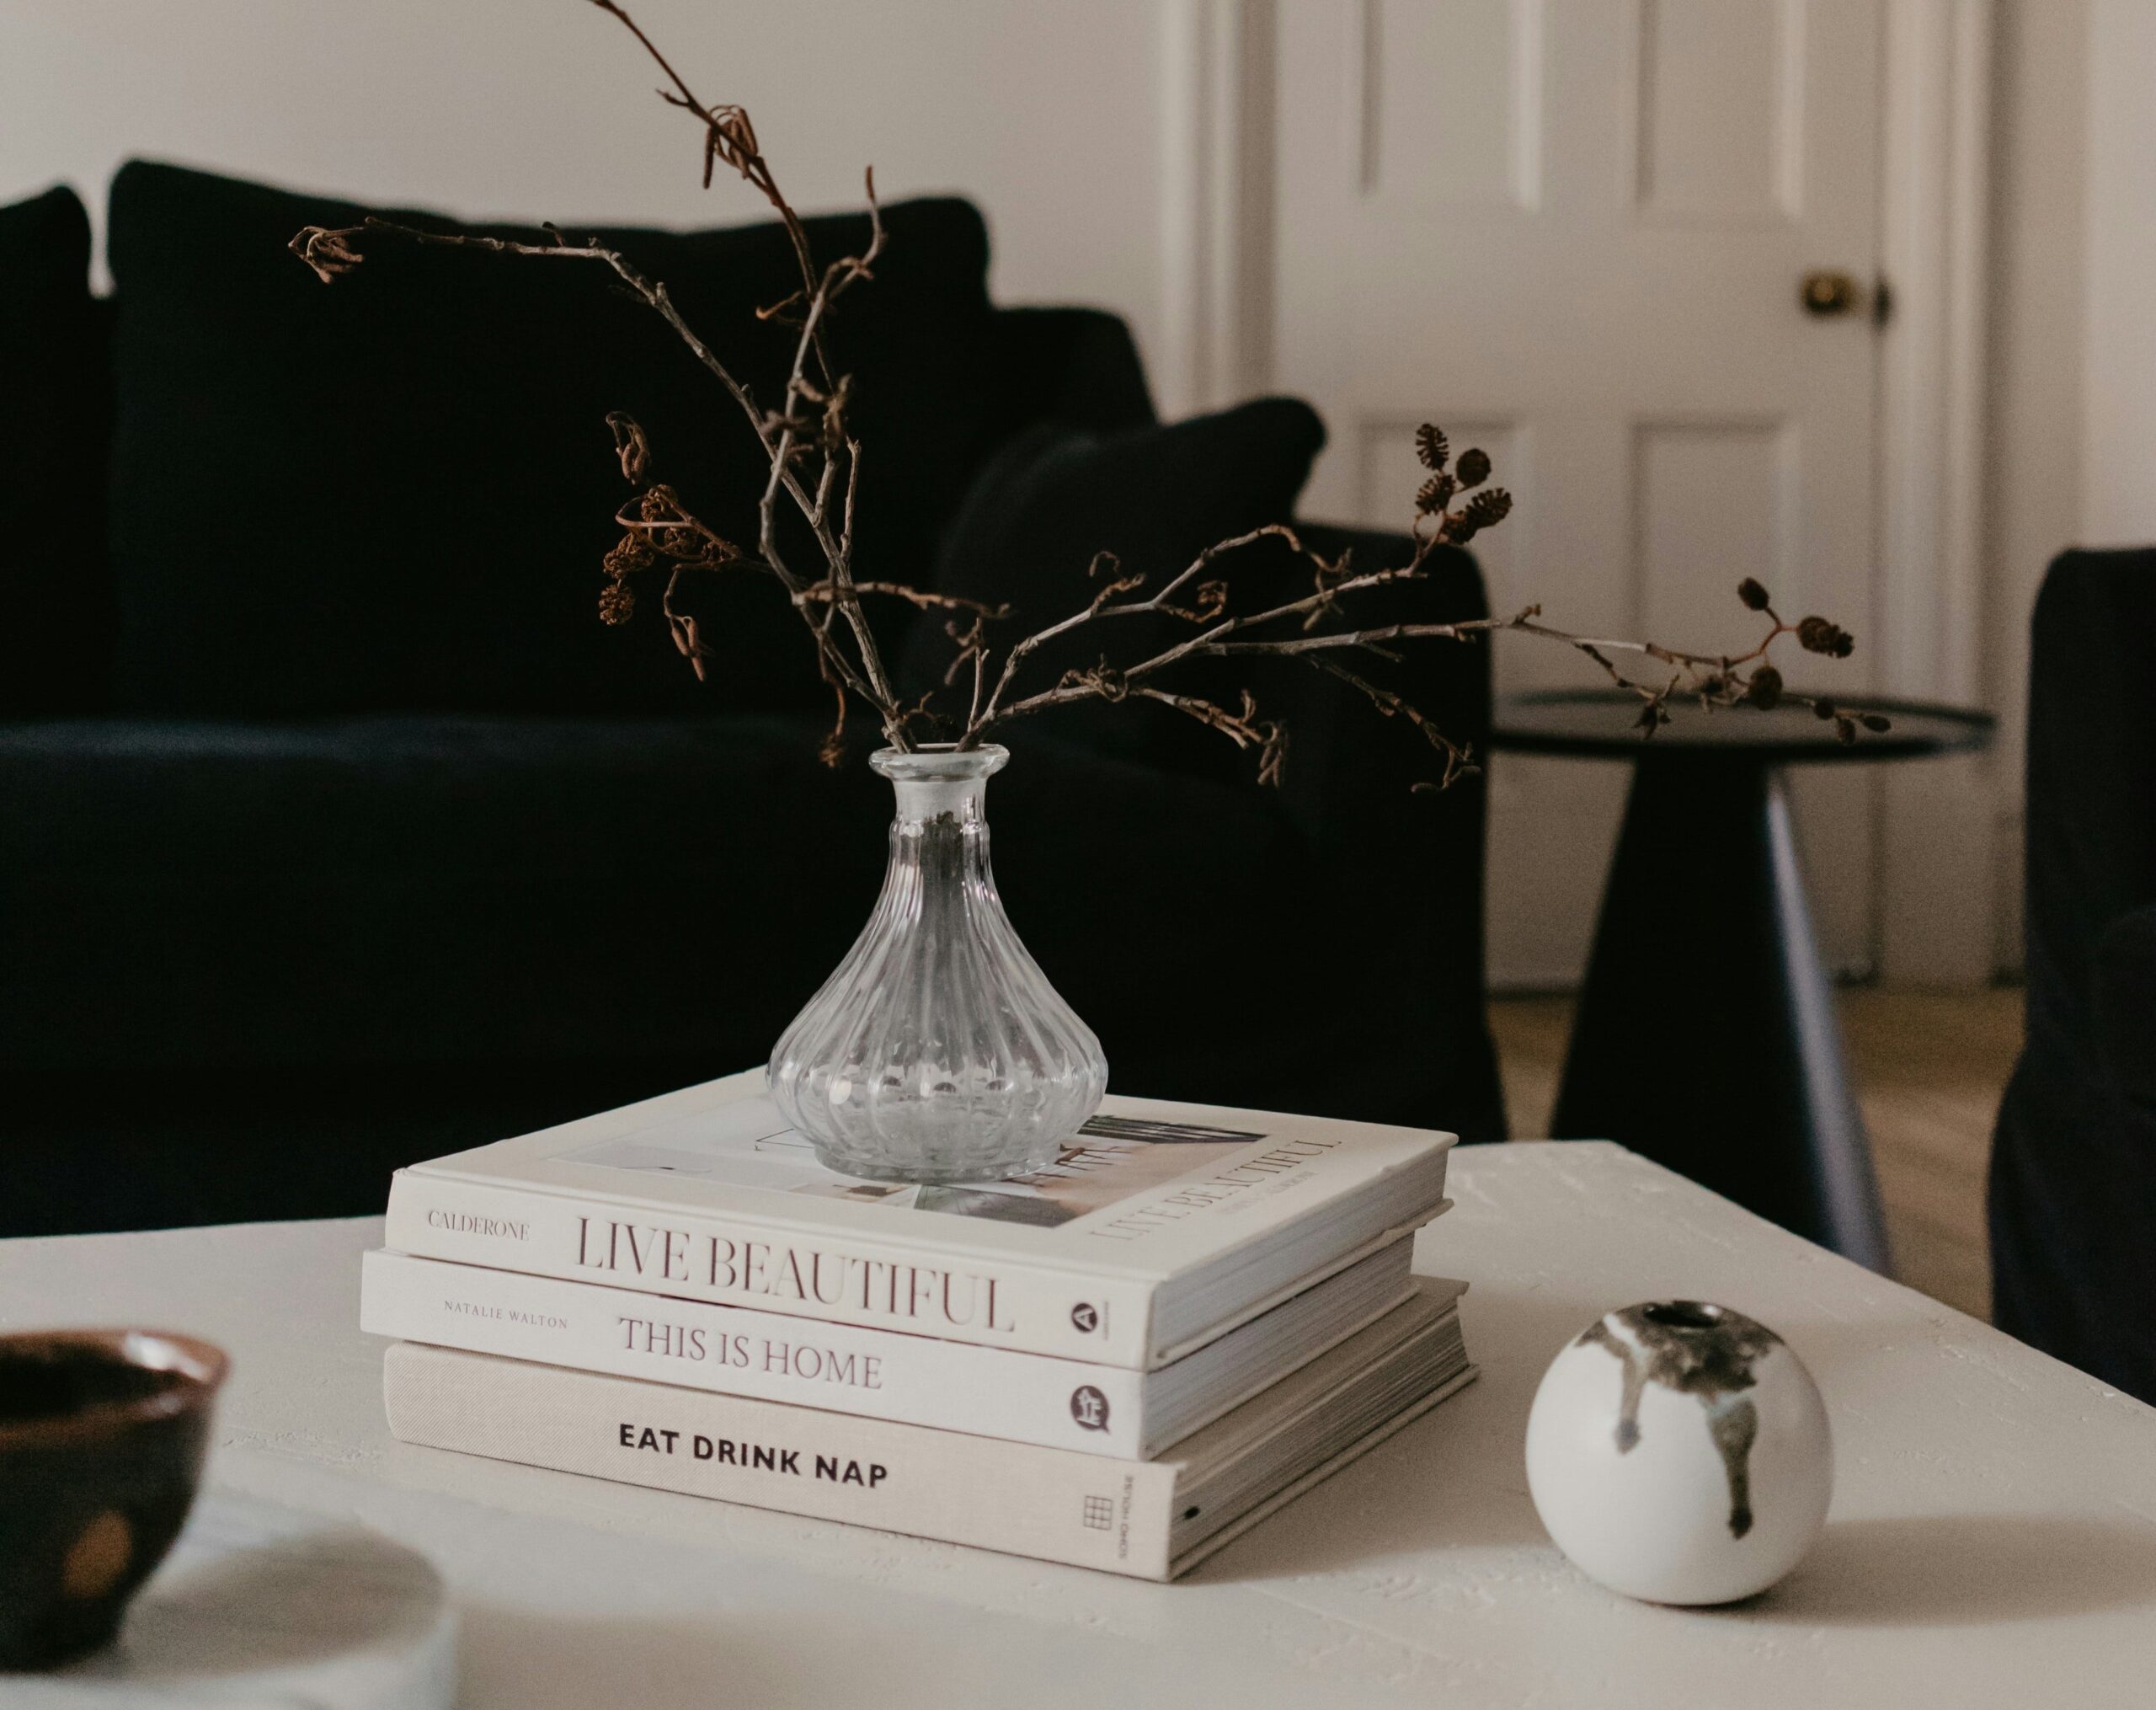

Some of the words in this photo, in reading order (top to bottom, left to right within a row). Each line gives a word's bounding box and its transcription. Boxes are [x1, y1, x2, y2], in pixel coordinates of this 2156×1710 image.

[1090, 1206, 1191, 1240] LIVE
[1164, 1140, 1342, 1208] BEAUTIFUL
[428, 1210, 531, 1242] CALDERONE
[576, 1216, 691, 1281] LIVE
[707, 1236, 1015, 1333] BEAUTIFUL
[444, 1300, 503, 1320] NATALIE
[509, 1311, 568, 1329] WALTON
[618, 1317, 706, 1361] THIS
[718, 1332, 750, 1369] IS
[762, 1339, 883, 1390] HOME
[619, 1423, 680, 1455] EAT
[693, 1435, 801, 1476] DRINK
[814, 1454, 888, 1488] NAP
